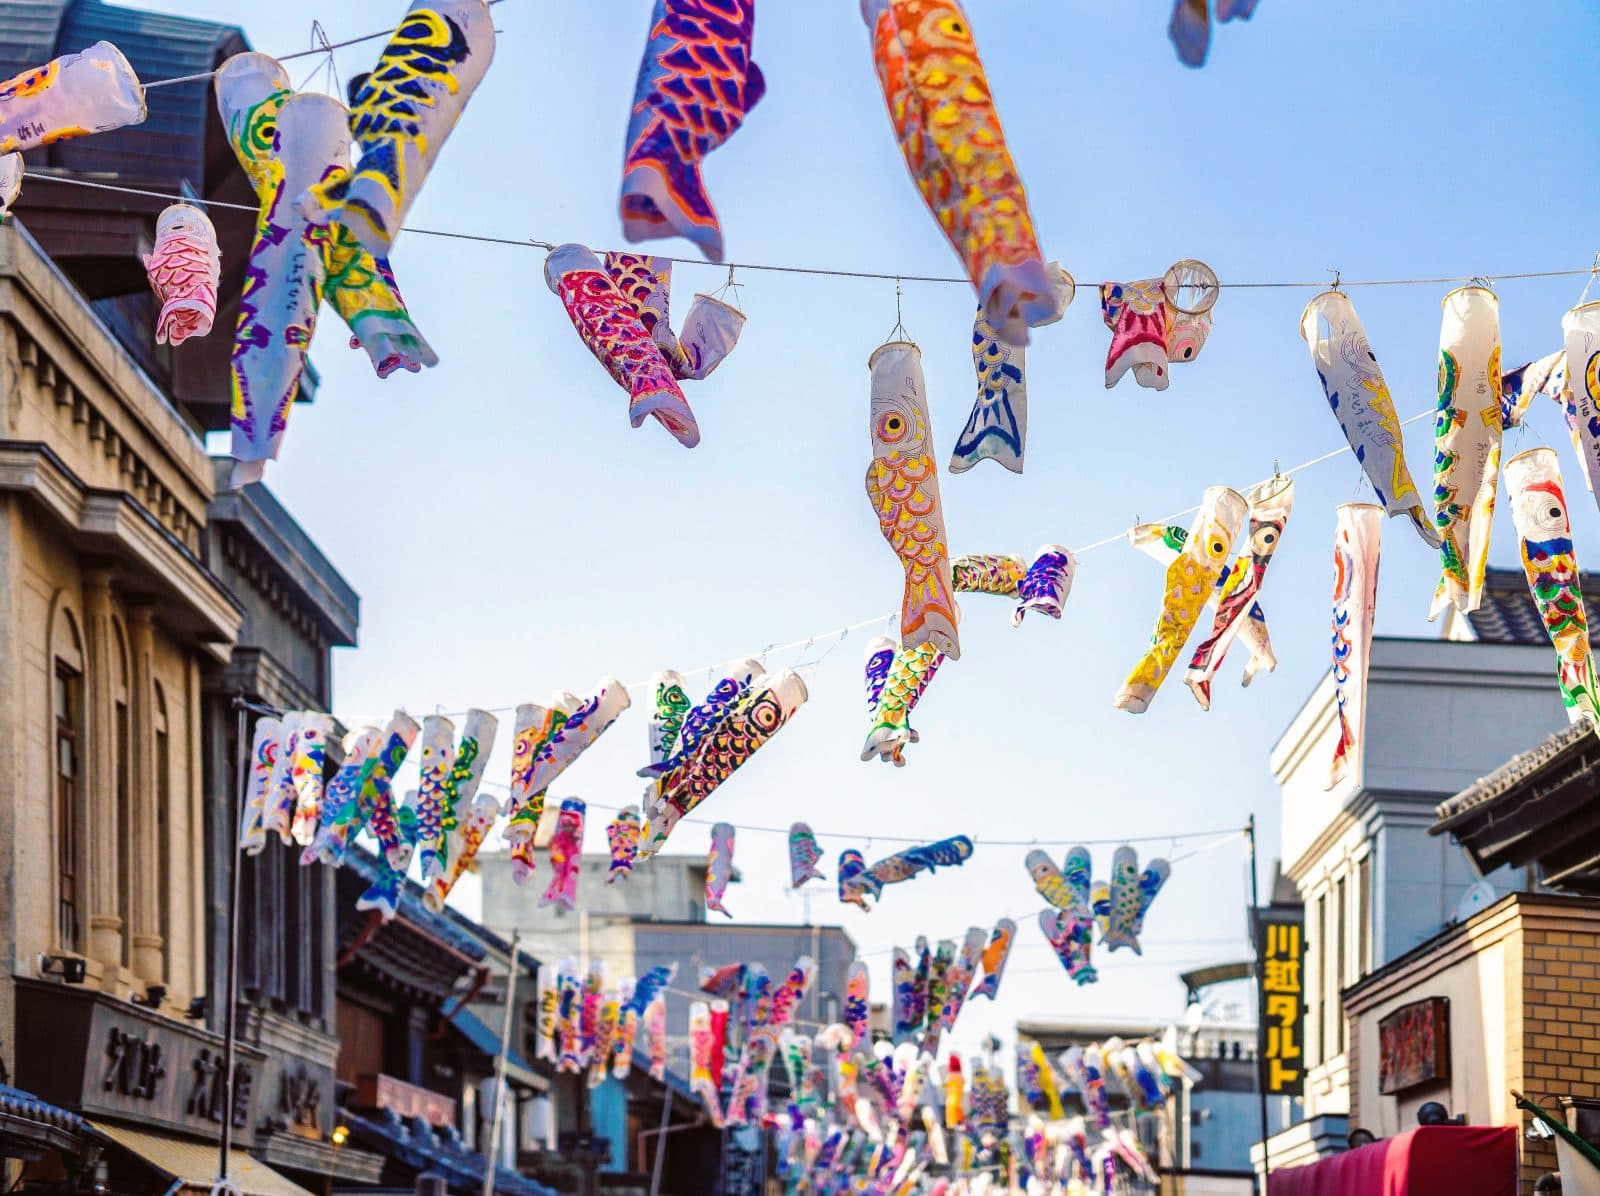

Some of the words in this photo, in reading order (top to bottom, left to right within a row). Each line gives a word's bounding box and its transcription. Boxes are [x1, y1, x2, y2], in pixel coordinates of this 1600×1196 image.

[1264, 924, 1300, 1090] 川越タルト
